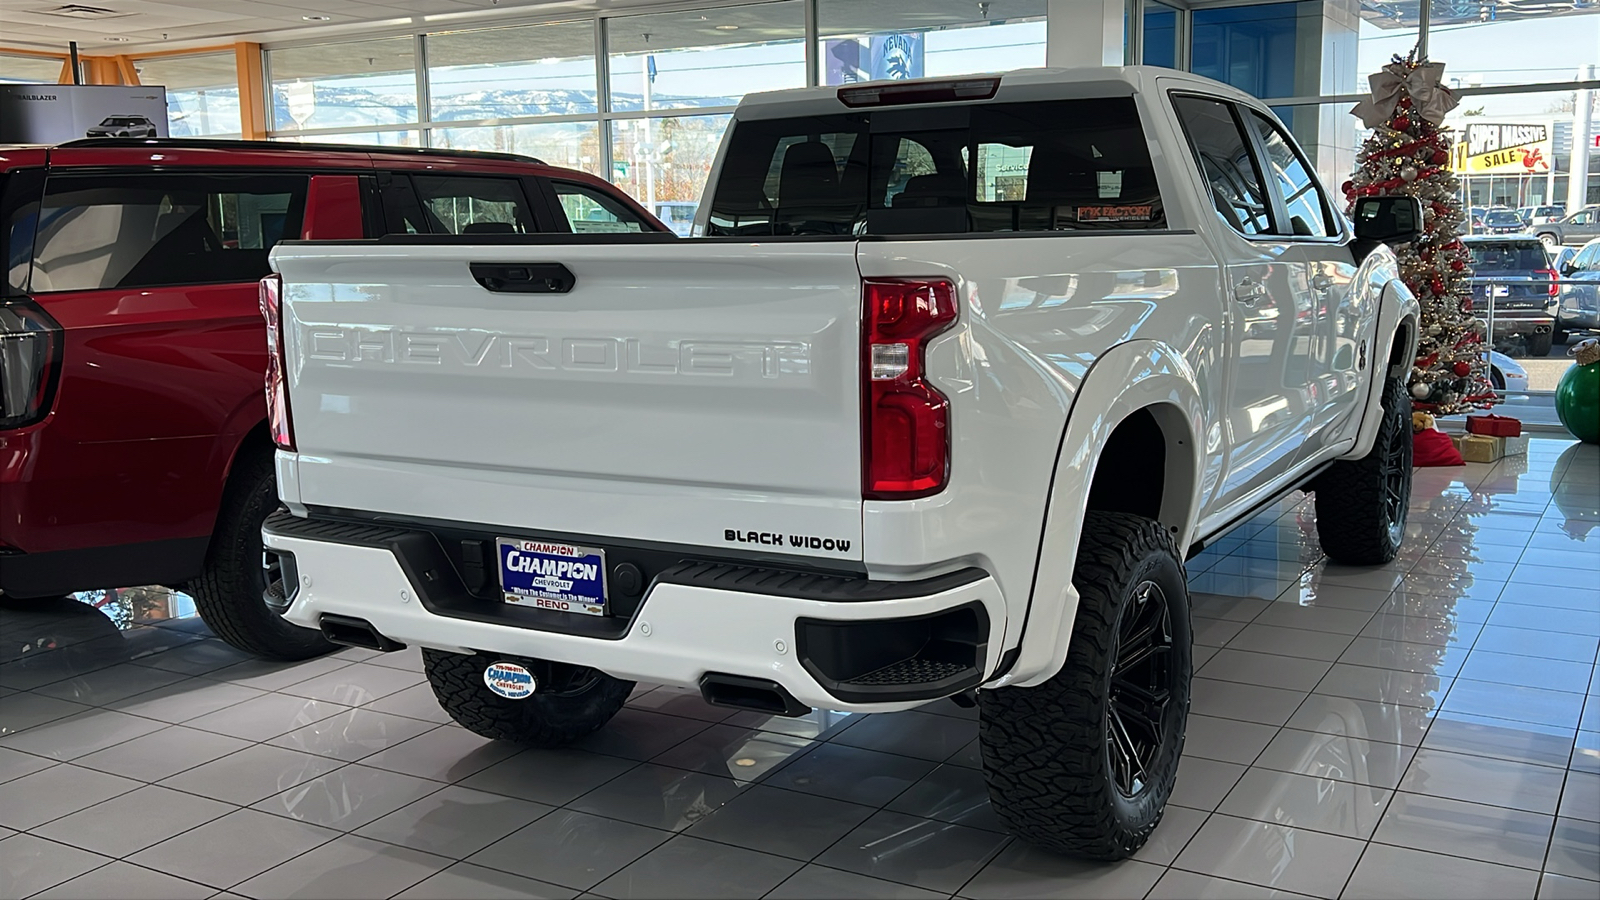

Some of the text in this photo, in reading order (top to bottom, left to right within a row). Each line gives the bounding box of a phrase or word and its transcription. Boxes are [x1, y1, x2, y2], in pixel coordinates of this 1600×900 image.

[883, 34, 912, 64] NEVADA
[1469, 124, 1500, 155] SUPER
[1501, 124, 1546, 148] MASSIVE
[1484, 150, 1516, 168] SALE
[1102, 205, 1152, 216] FACTORY
[307, 328, 813, 379] CHEVROLET
[524, 542, 574, 556] CHAMPION
[724, 529, 851, 553] BLACK WIDOW
[506, 551, 598, 581] CHAMPION
[534, 578, 570, 589] CHEVROLET
[536, 599, 570, 610] RENO
[496, 681, 524, 691] CHEVROLET
